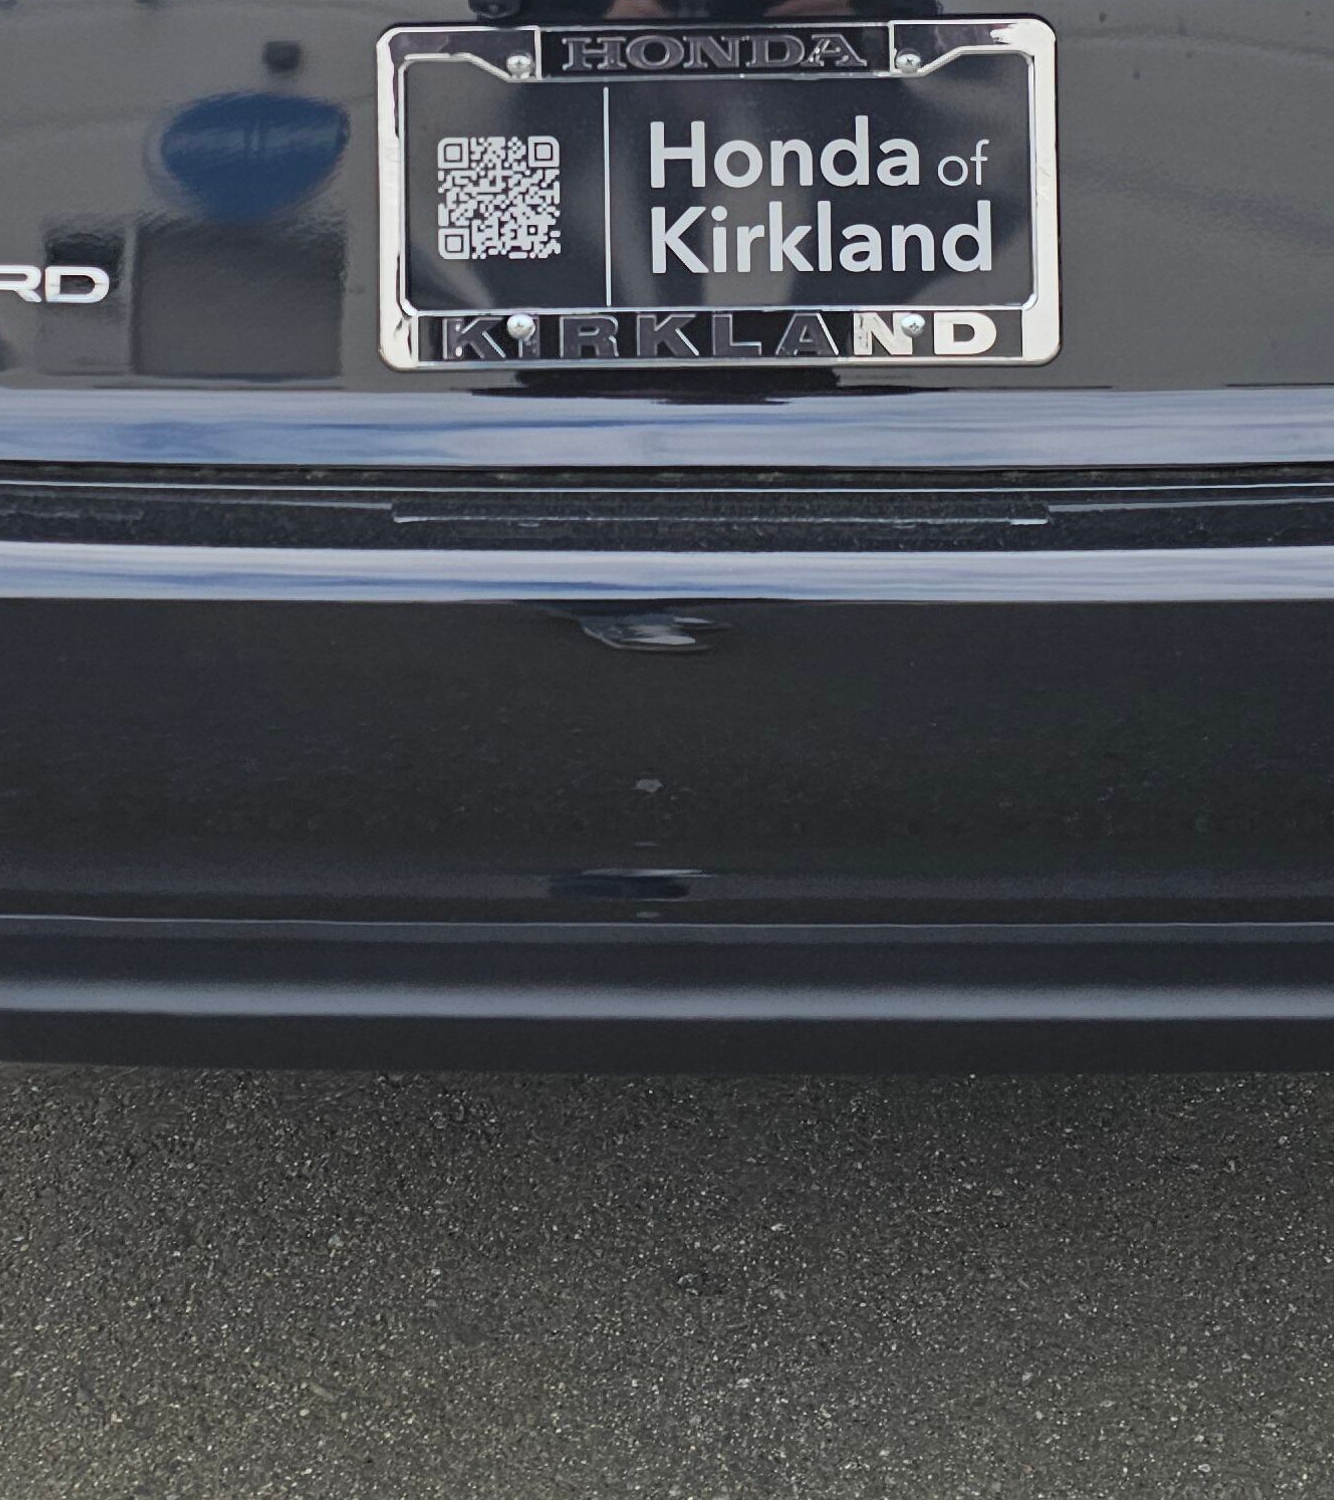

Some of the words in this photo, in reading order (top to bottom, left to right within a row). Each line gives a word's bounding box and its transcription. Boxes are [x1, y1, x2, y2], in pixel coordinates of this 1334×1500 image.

[562, 33, 866, 72] HONDA
[650, 115, 919, 188] Honda
[936, 138, 989, 187] of
[650, 200, 992, 274] Kirkland
[442, 313, 998, 360] KIRKLAND
